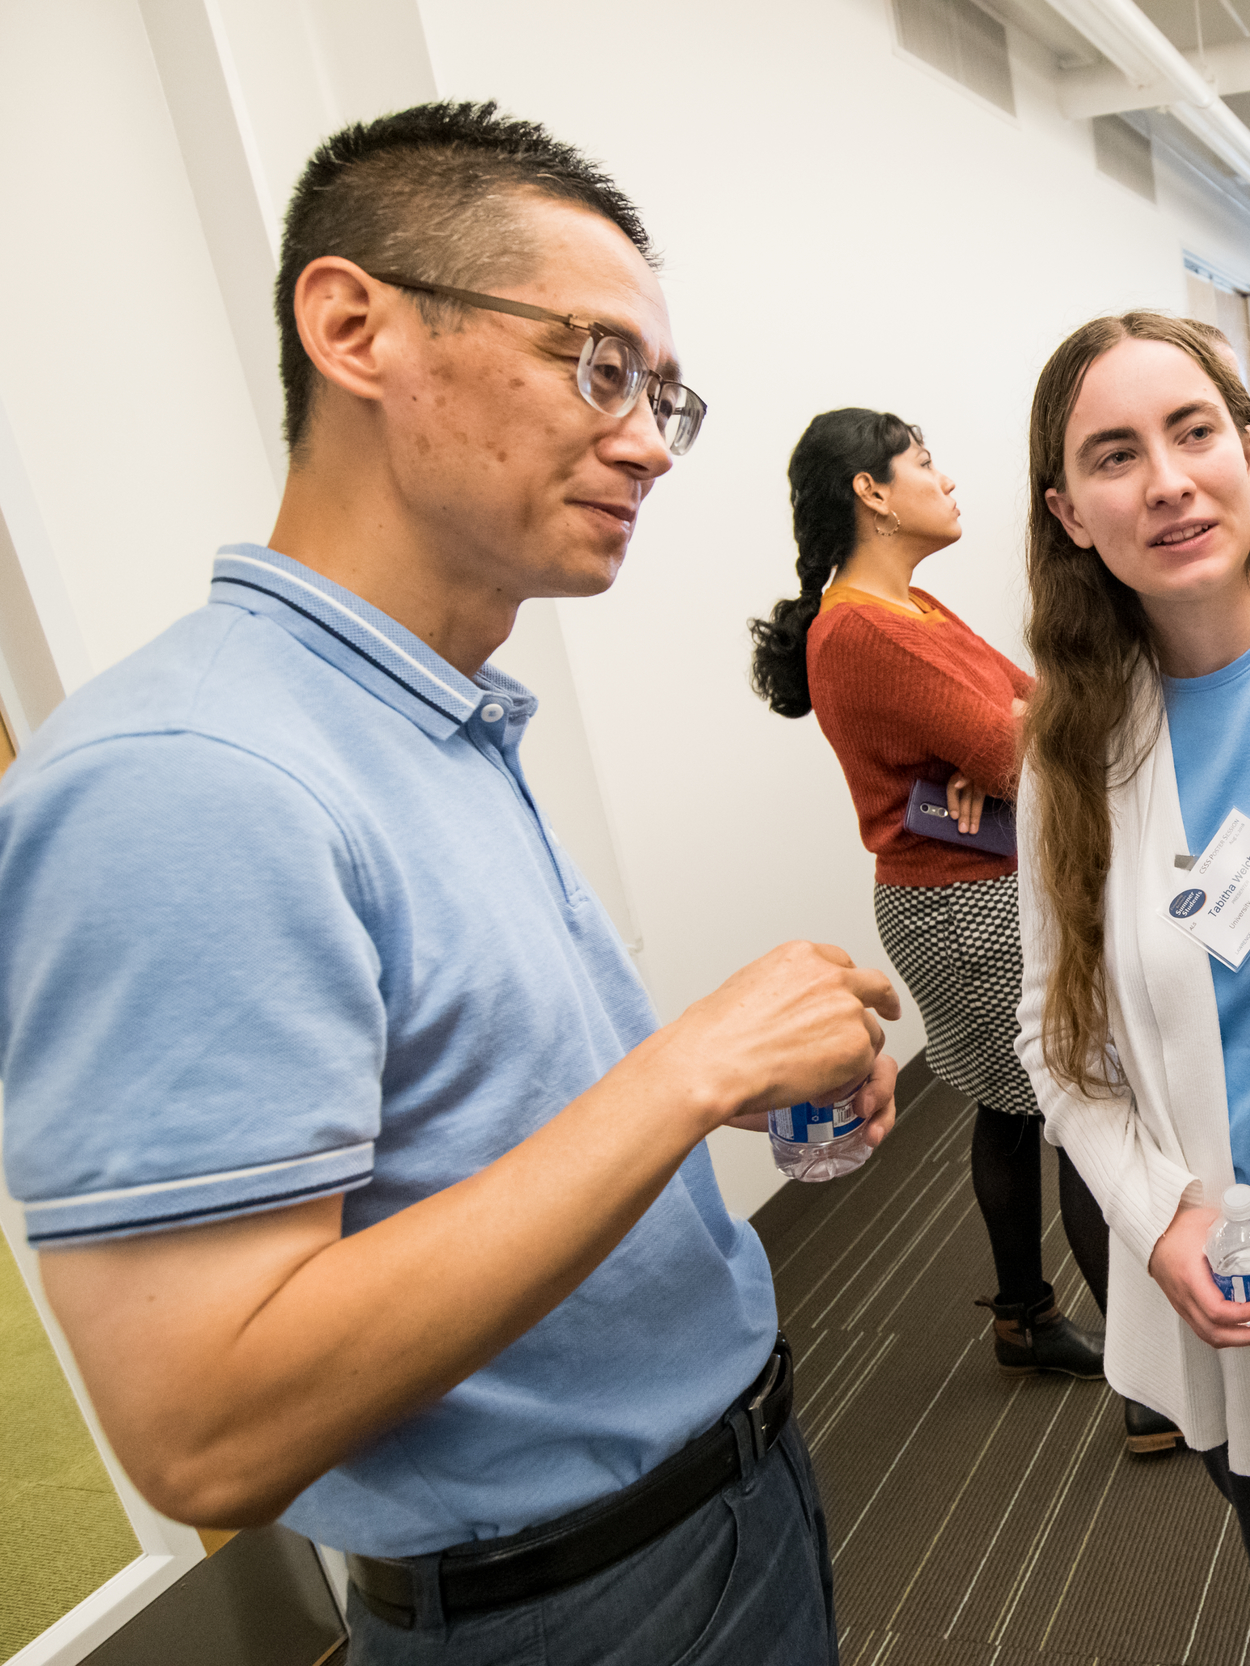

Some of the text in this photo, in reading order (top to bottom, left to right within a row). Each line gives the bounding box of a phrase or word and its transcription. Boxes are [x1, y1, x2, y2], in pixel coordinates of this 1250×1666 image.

[1175, 891, 1196, 916] Summer
[1182, 890, 1202, 917] Students
[1208, 883, 1236, 918] Tabitha
